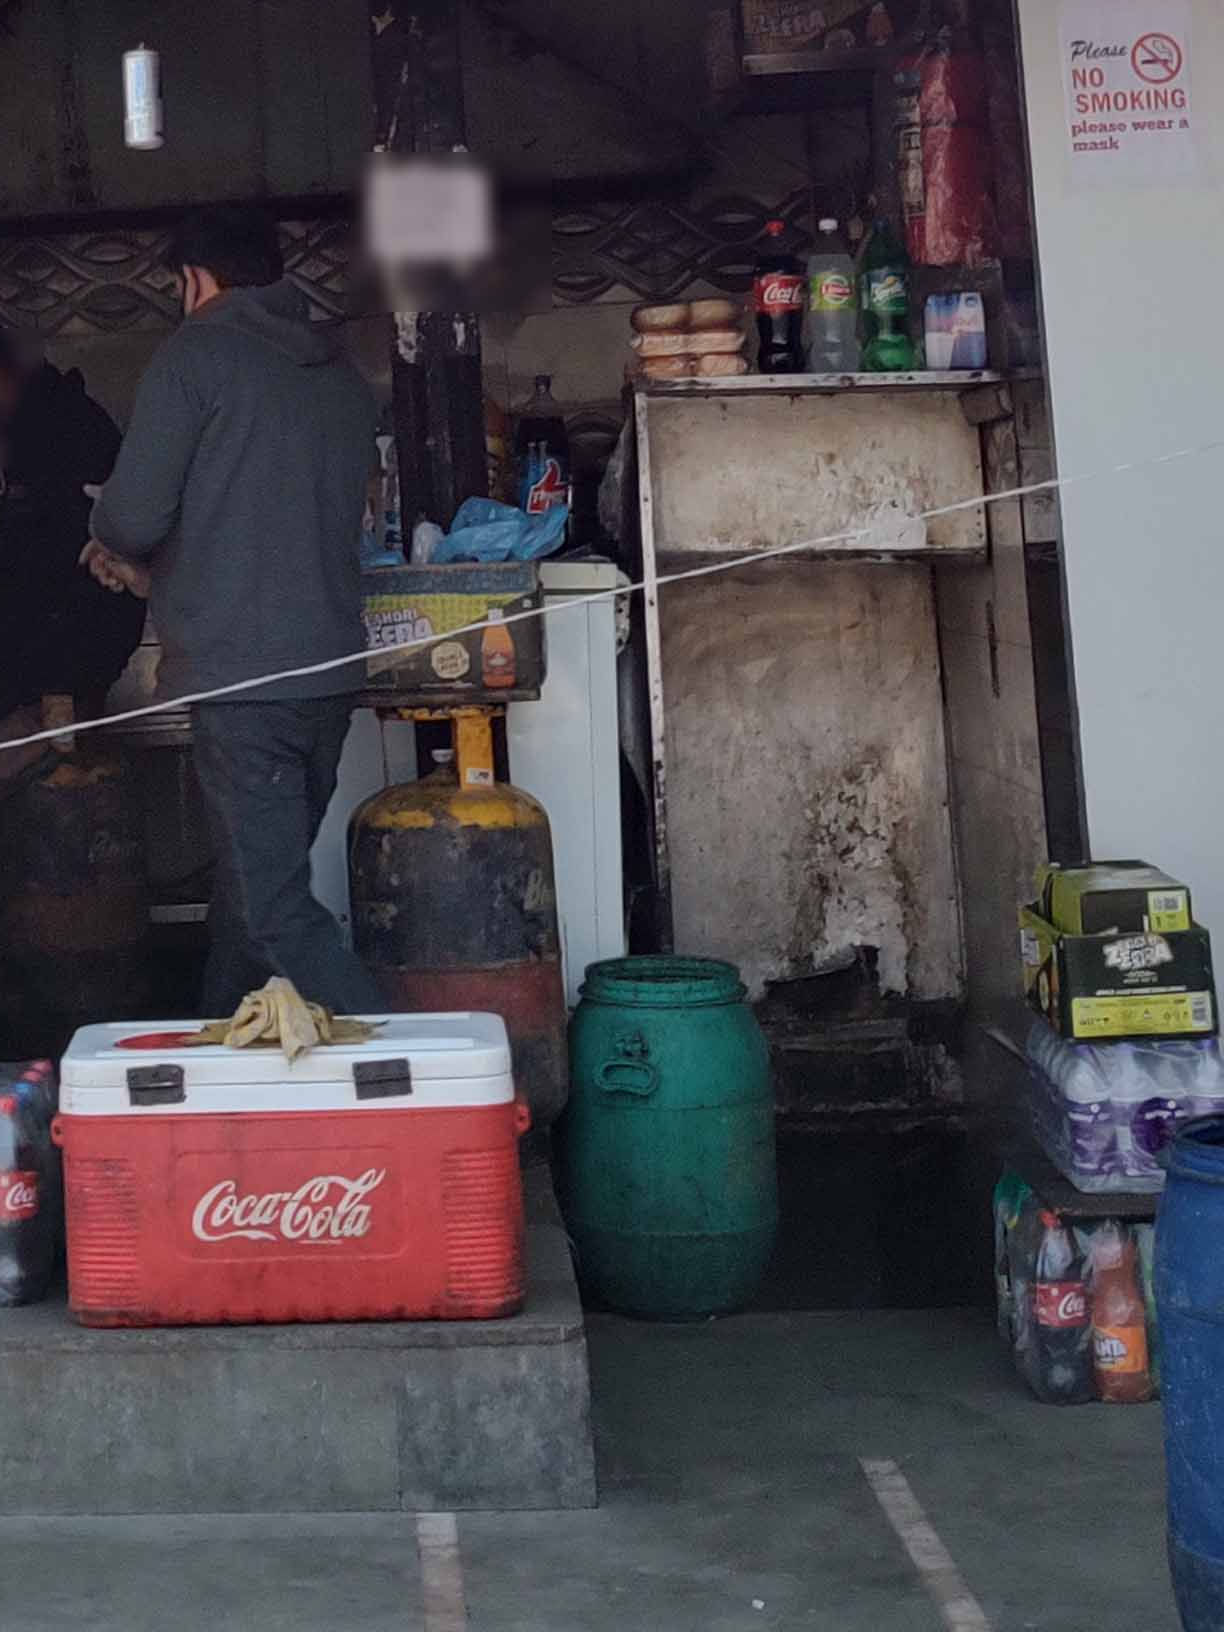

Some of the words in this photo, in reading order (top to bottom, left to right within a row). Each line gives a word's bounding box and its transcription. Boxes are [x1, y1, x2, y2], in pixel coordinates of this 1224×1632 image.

[1070, 40, 1128, 62] Please
[1072, 67, 1105, 88] NO
[1076, 88, 1187, 114] SMOKING
[1071, 120, 1127, 138] please
[1131, 119, 1175, 132] wear
[1073, 136, 1120, 152] mask
[192, 1168, 386, 1241] Coca-Cola
